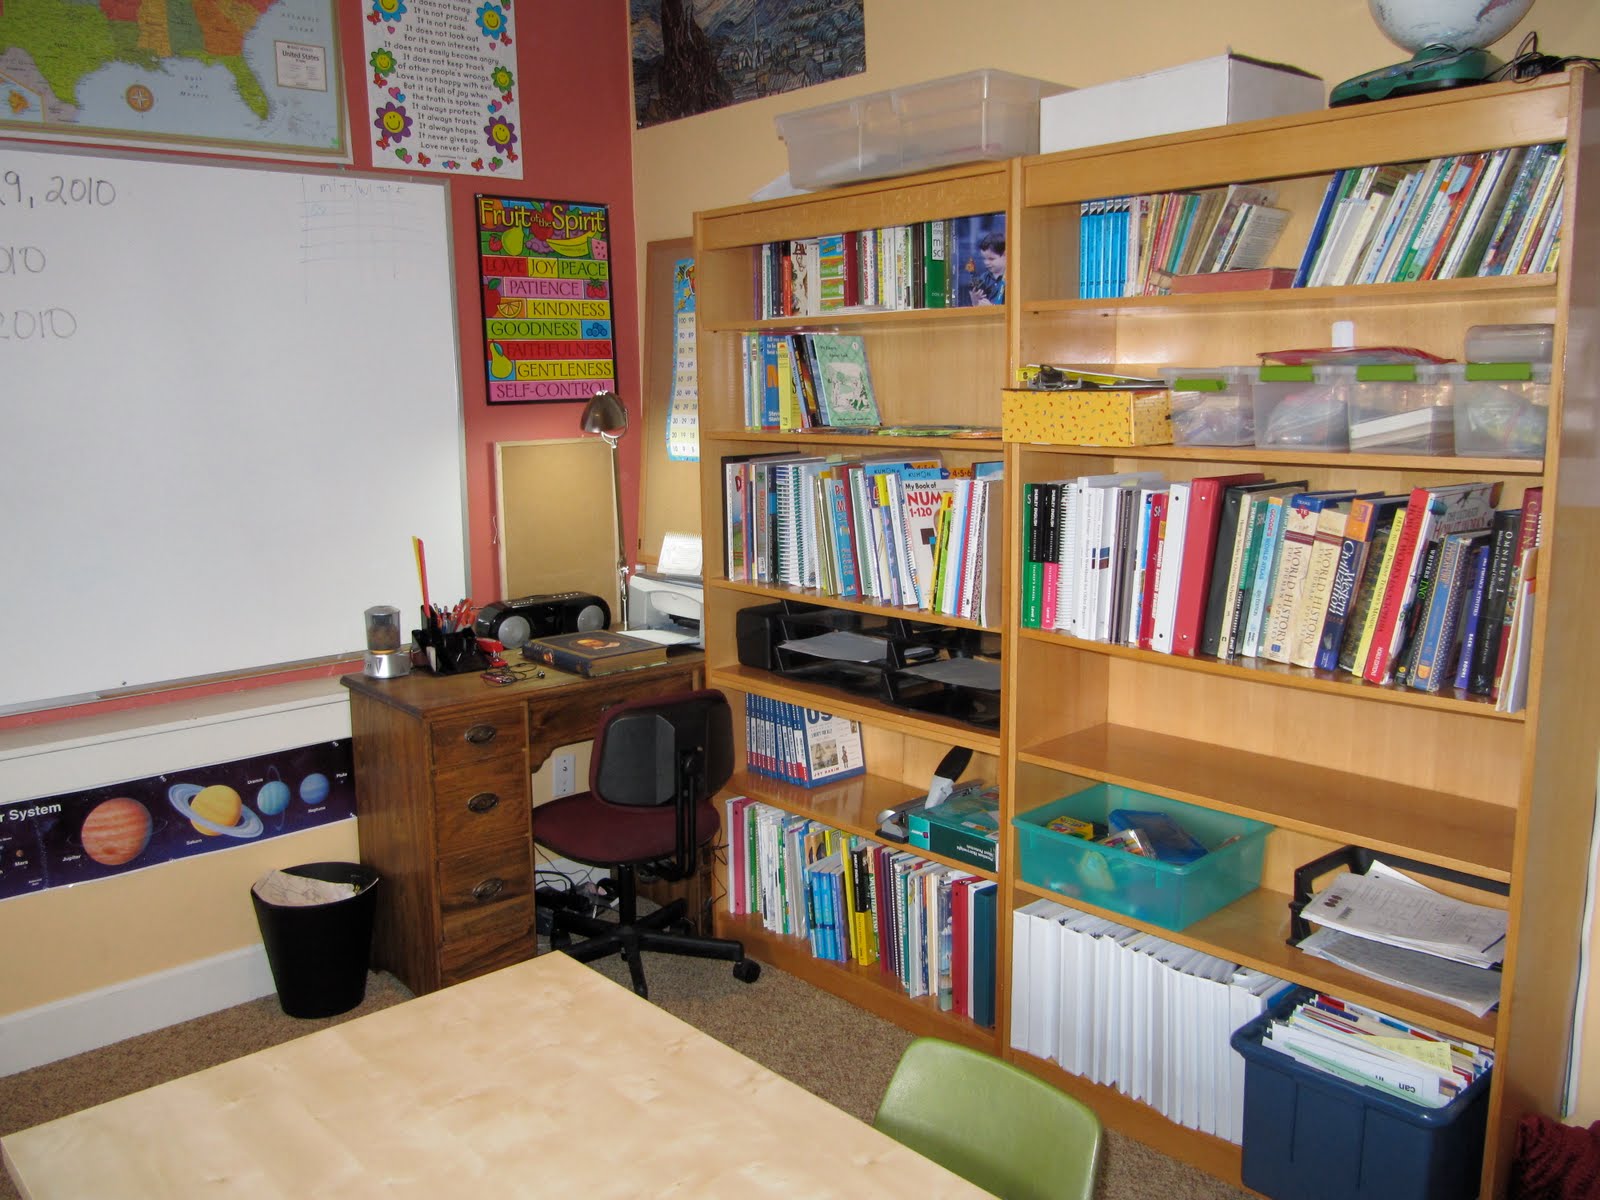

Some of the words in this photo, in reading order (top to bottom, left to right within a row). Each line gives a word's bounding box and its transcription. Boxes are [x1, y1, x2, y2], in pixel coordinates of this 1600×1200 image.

[431, 9, 443, 17] not
[404, 34, 416, 42] for
[416, 27, 433, 35] does
[449, 31, 464, 40] look
[282, 50, 300, 58] United
[302, 51, 319, 61] States
[394, 43, 412, 51] does
[414, 46, 427, 54] not
[429, 49, 449, 58] easily
[451, 51, 478, 60] become
[413, 56, 430, 64] does
[447, 59, 463, 69] keep
[466, 63, 484, 71] track
[440, 78, 461, 88] happy
[463, 81, 478, 89] with
[457, 90, 469, 98] joy
[421, 105, 447, 114] always
[427, 114, 452, 124] always
[429, 124, 454, 133] always
[428, 133, 447, 141] never
[5, 171, 33, 208] 9,
[46, 175, 116, 206] 2010
[481, 200, 531, 227] Fruit
[530, 213, 539, 222] of
[538, 219, 551, 227] the
[552, 205, 606, 238] Spirit
[485, 257, 522, 272] LOVE
[529, 260, 557, 275] JOY
[561, 262, 606, 276] PEACE
[510, 282, 579, 296] PATIENCE
[533, 302, 606, 317] KINDNESS
[491, 322, 578, 337] GOODNESS
[505, 343, 611, 356] FAITHFULNESS
[518, 363, 612, 377] GENTLENESS
[909, 508, 932, 518] 1-120
[1521, 500, 1538, 548] CHIN
[1497, 530, 1513, 582] OMNIBUS
[1257, 561, 1267, 580] ATLAS
[1285, 545, 1303, 590] WORLD
[1318, 547, 1335, 592] WORLD
[1423, 549, 1435, 579] WRITERS
[1278, 567, 1289, 598] HUMAN
[1307, 568, 1319, 600] HUMAN
[1328, 540, 1354, 614] Civilization
[1340, 572, 1354, 616] Western
[1416, 579, 1429, 600] INC
[1276, 593, 1292, 644] HISTORY
[1304, 596, 1324, 646] HISTORY
[9, 804, 62, 822] System
[62, 854, 82, 862] Jupiter
